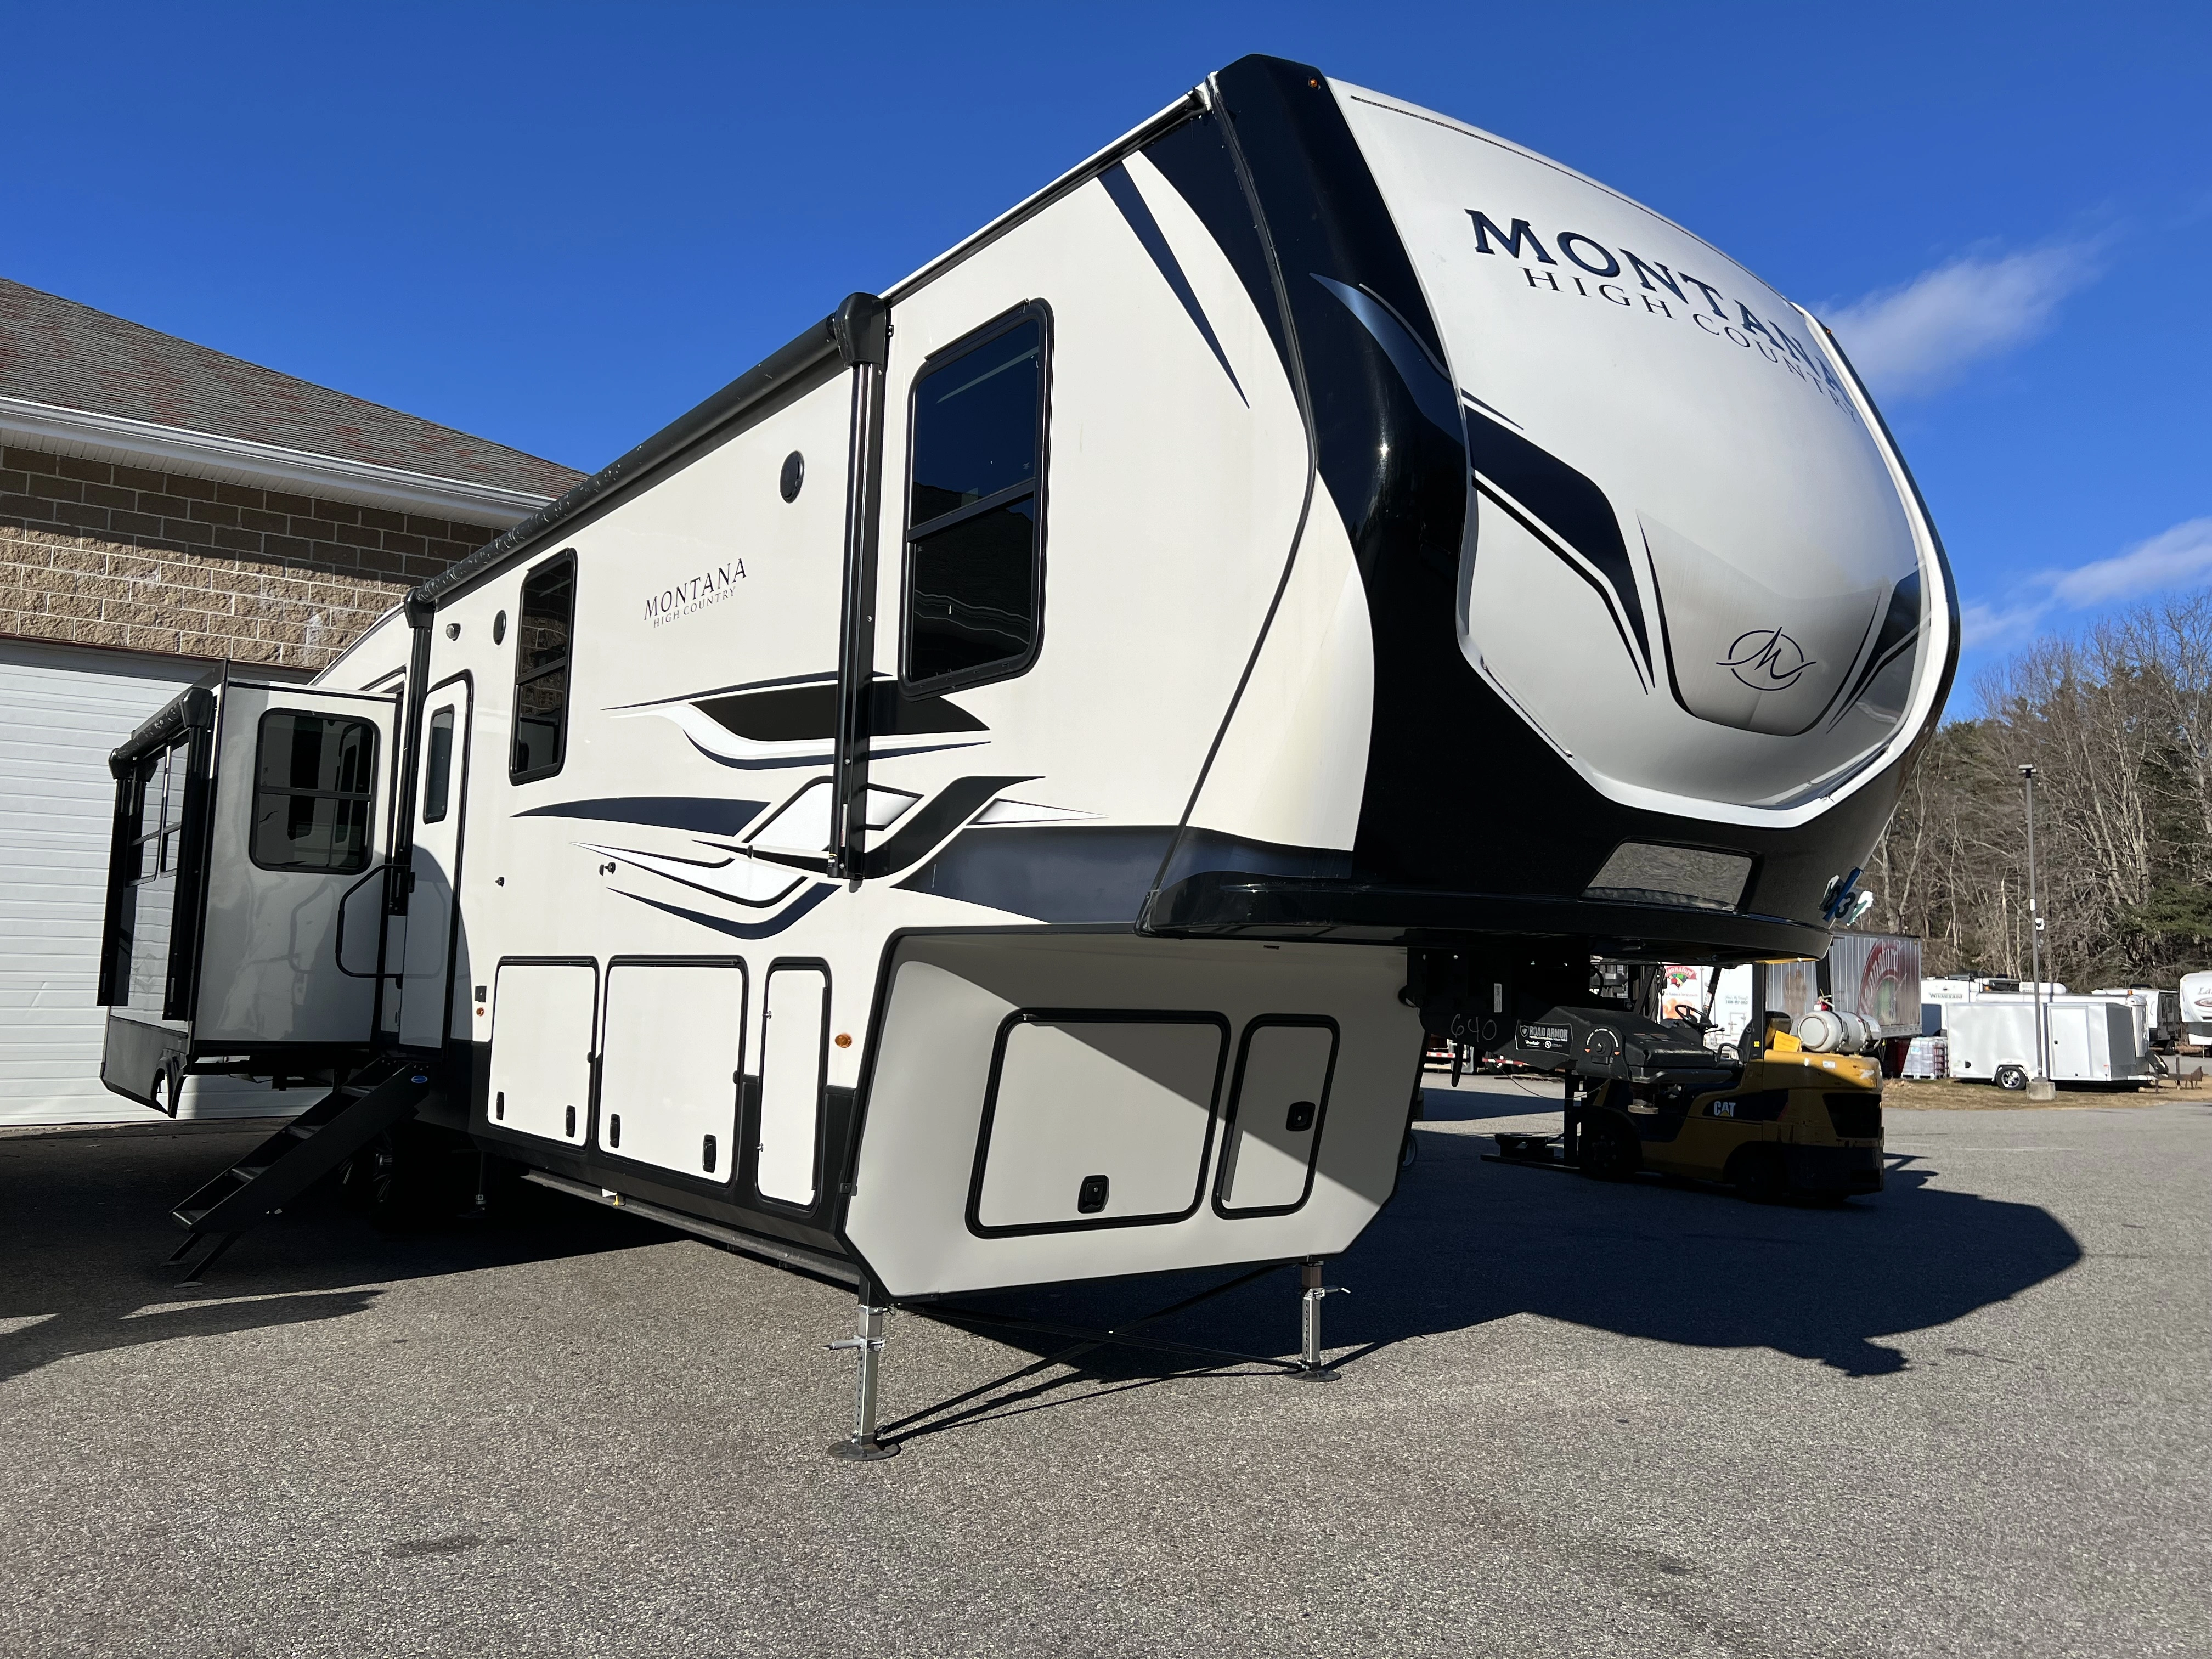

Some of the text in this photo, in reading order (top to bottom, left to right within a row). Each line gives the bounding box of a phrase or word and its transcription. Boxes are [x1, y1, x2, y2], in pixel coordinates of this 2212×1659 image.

[1464, 208, 1854, 410] MONTANA
[1519, 267, 1858, 425] HIGH COUNTRY
[644, 558, 747, 620] MONTANA
[653, 586, 736, 628] HIGH COUNTRY
[1451, 1014, 1497, 1042] 640
[1529, 1026, 1546, 1037] ROAD
[1546, 1027, 1568, 1039] ARMOR
[1713, 1101, 1736, 1118] CAT
